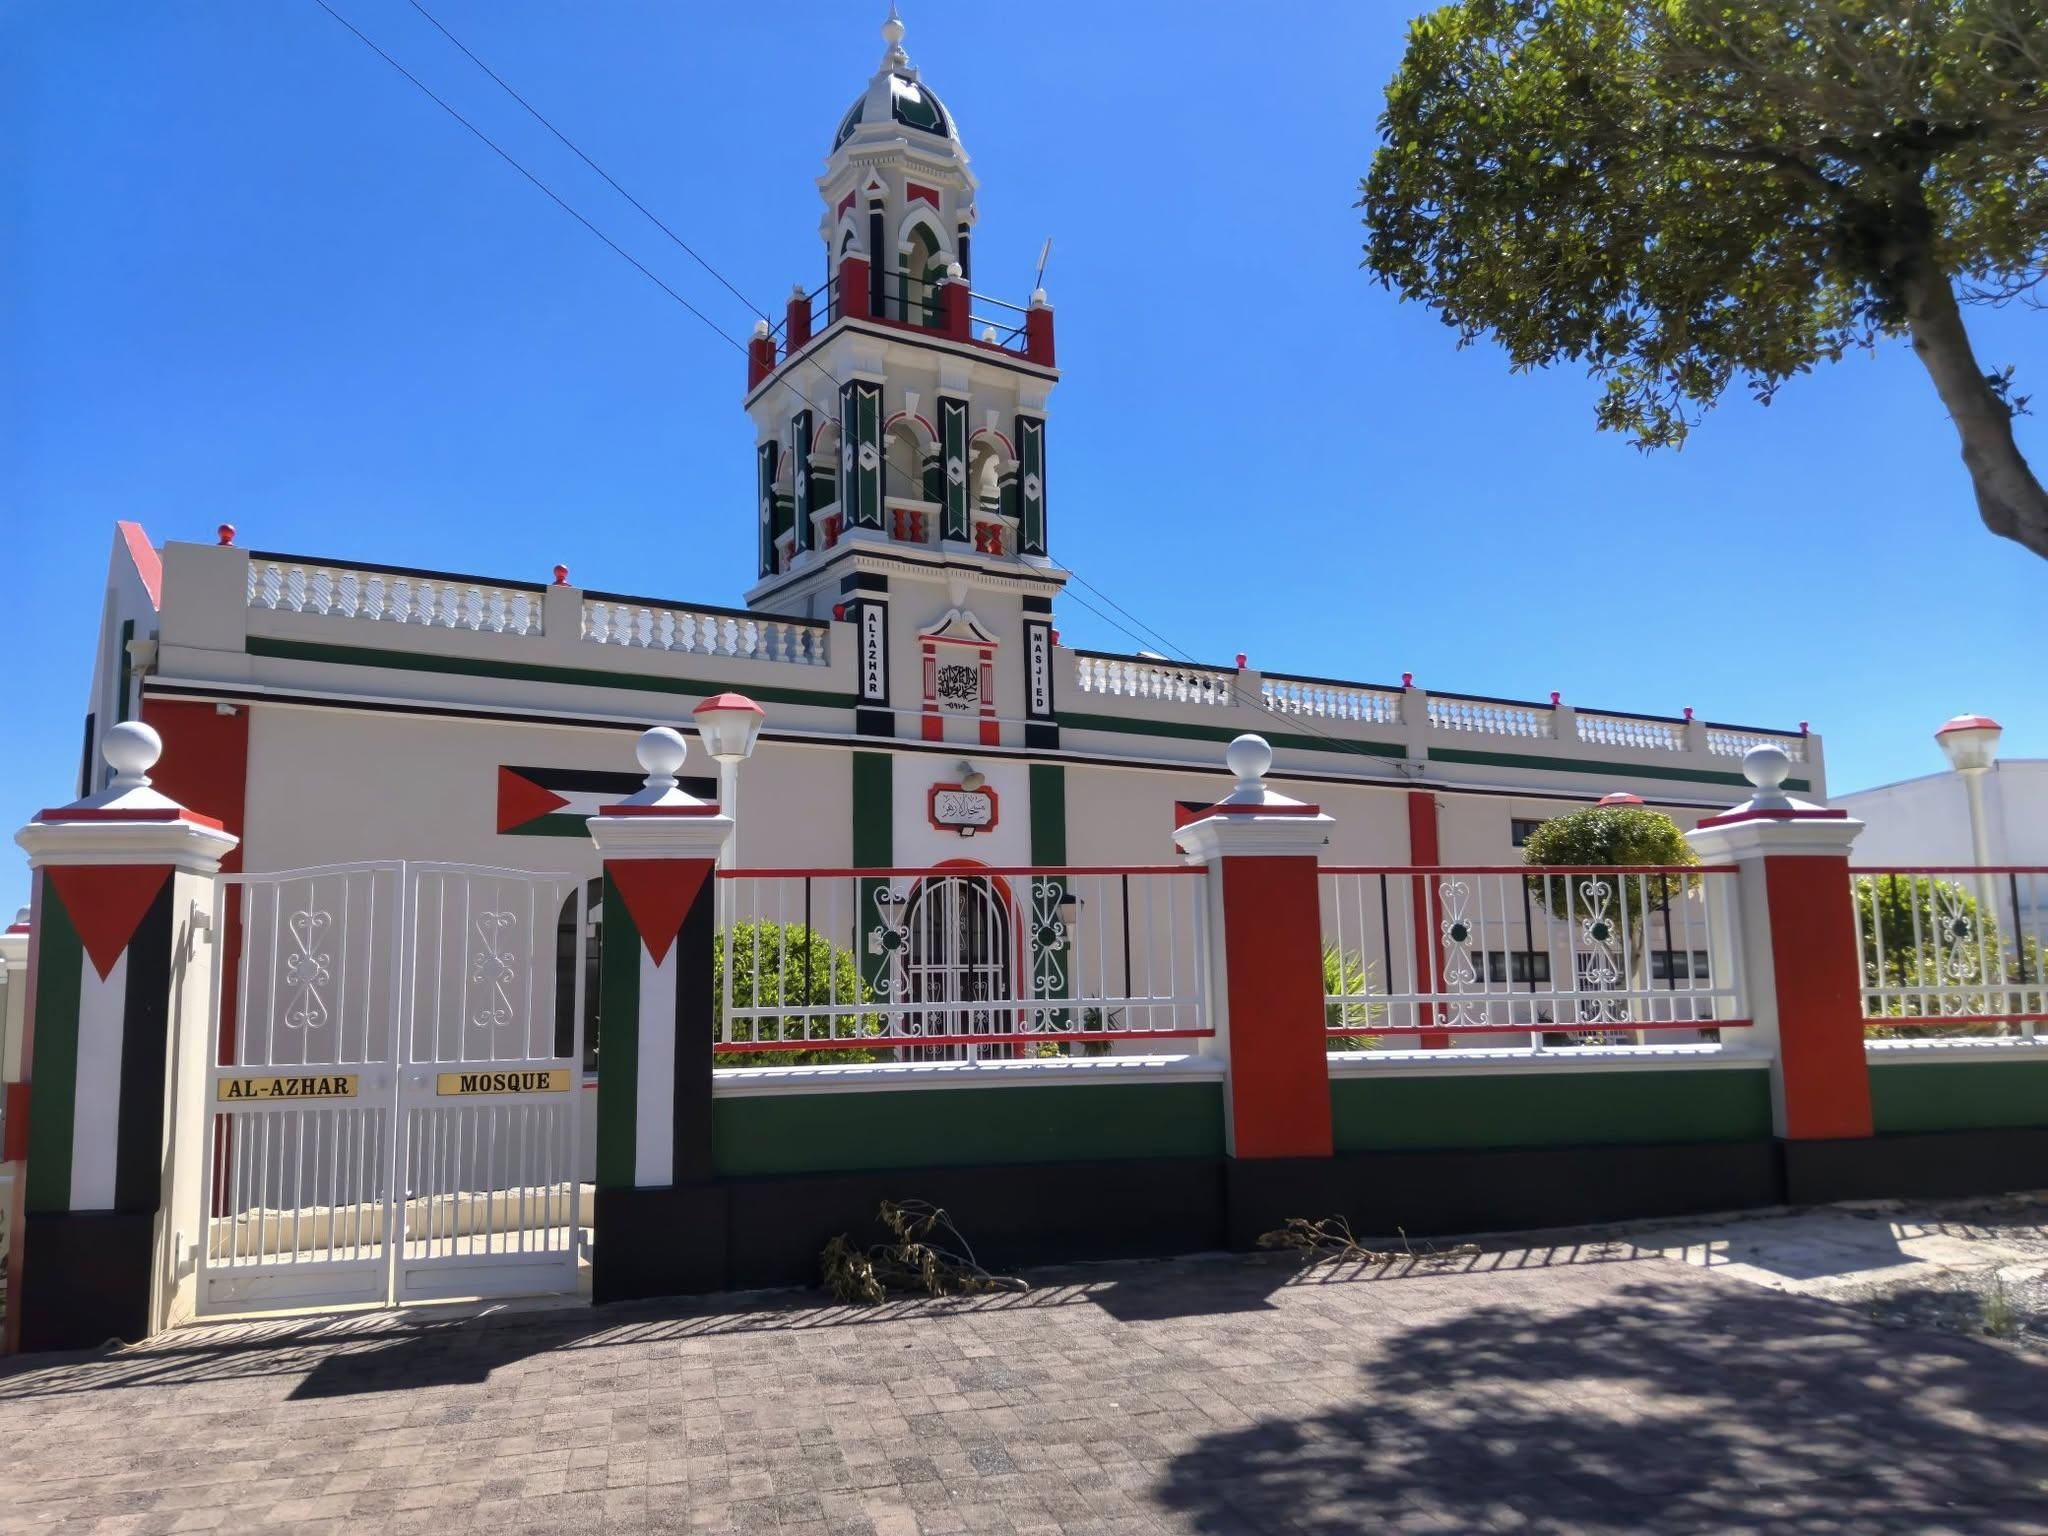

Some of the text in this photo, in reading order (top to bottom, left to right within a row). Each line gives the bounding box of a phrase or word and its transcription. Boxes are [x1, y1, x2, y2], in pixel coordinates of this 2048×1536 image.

[1033, 633, 1043, 707] MASJIED
[228, 1077, 349, 1098] AL-AZHAR
[460, 1072, 550, 1092] MOSQUE
